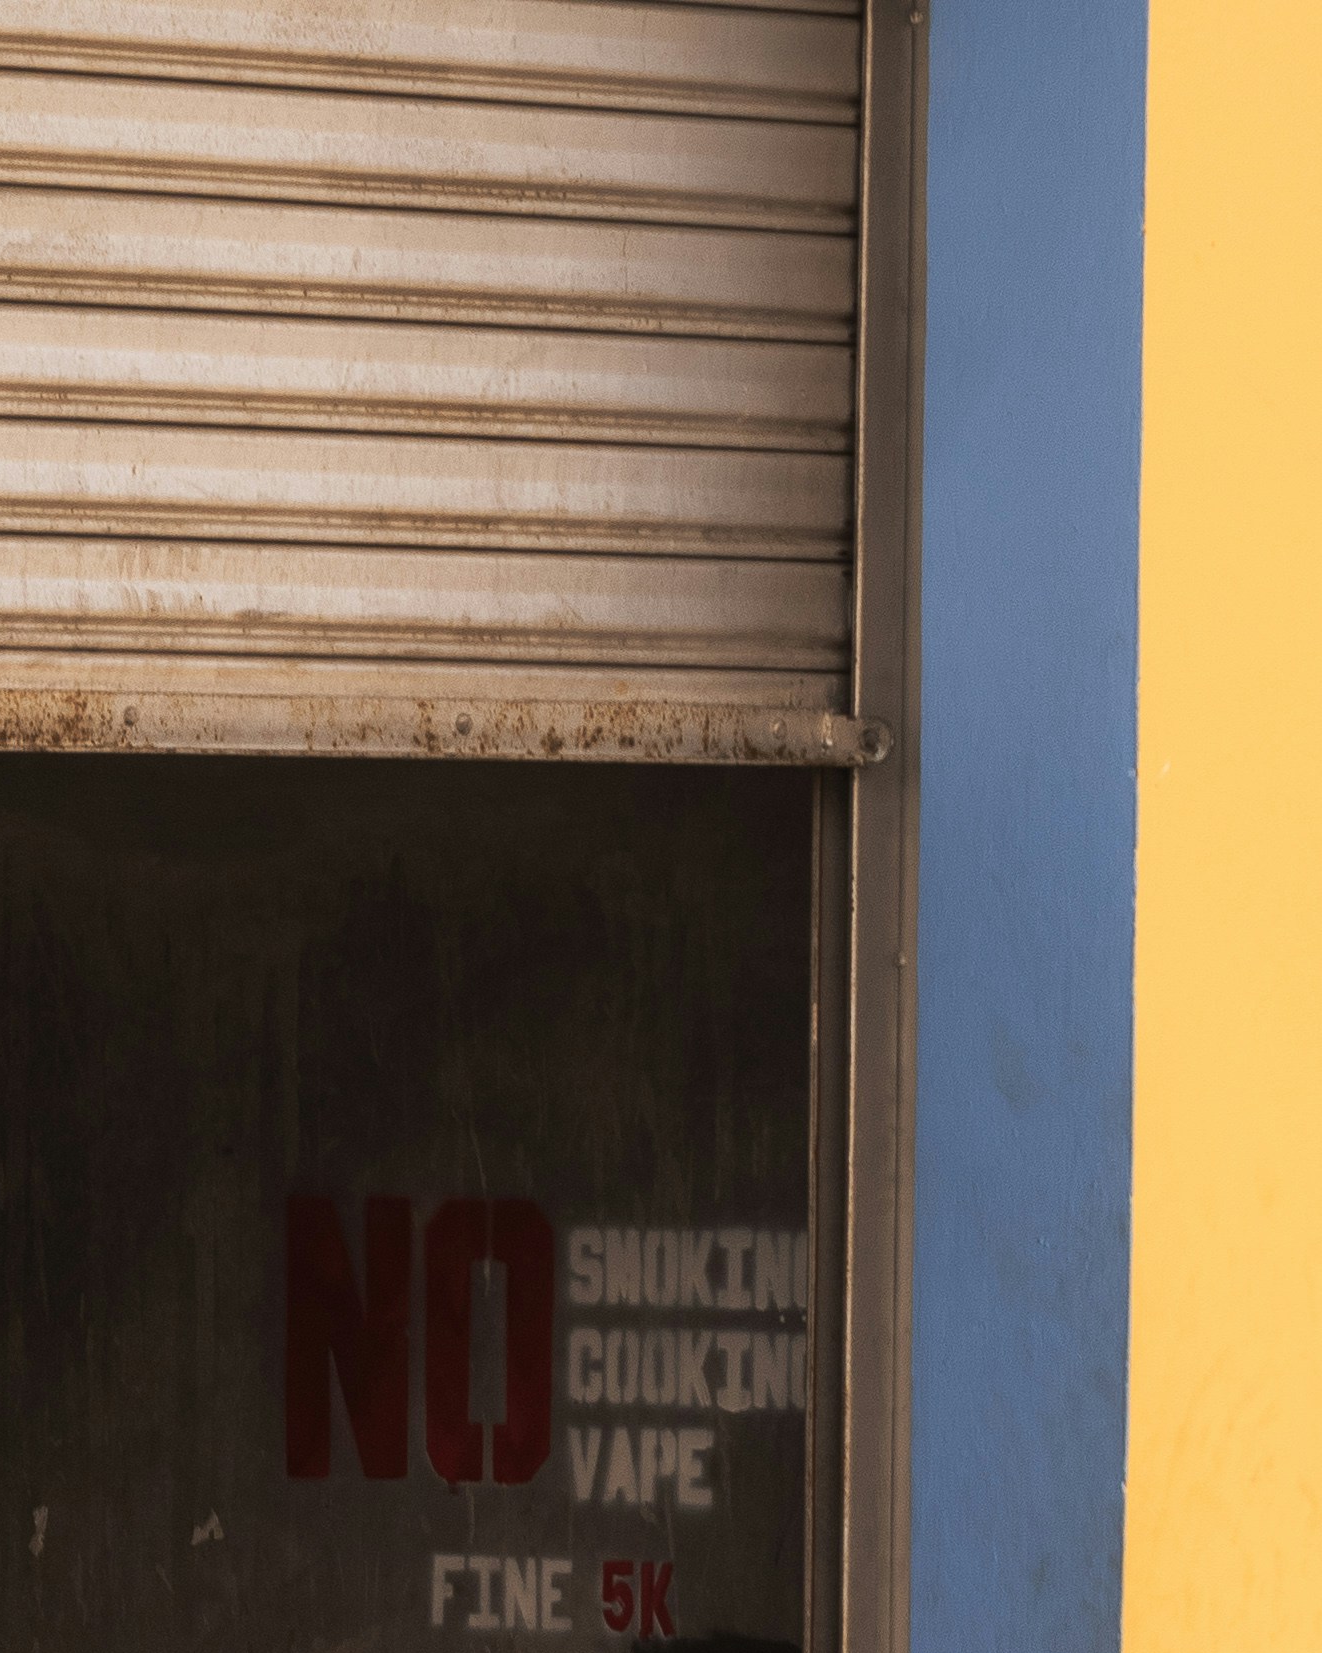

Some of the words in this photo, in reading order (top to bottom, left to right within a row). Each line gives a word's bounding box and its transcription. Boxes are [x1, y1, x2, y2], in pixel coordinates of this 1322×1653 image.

[285, 1195, 555, 1486] NO
[568, 1426, 715, 1505] VAPE
[430, 1552, 574, 1631] FINE
[601, 1560, 676, 1638] 5K
